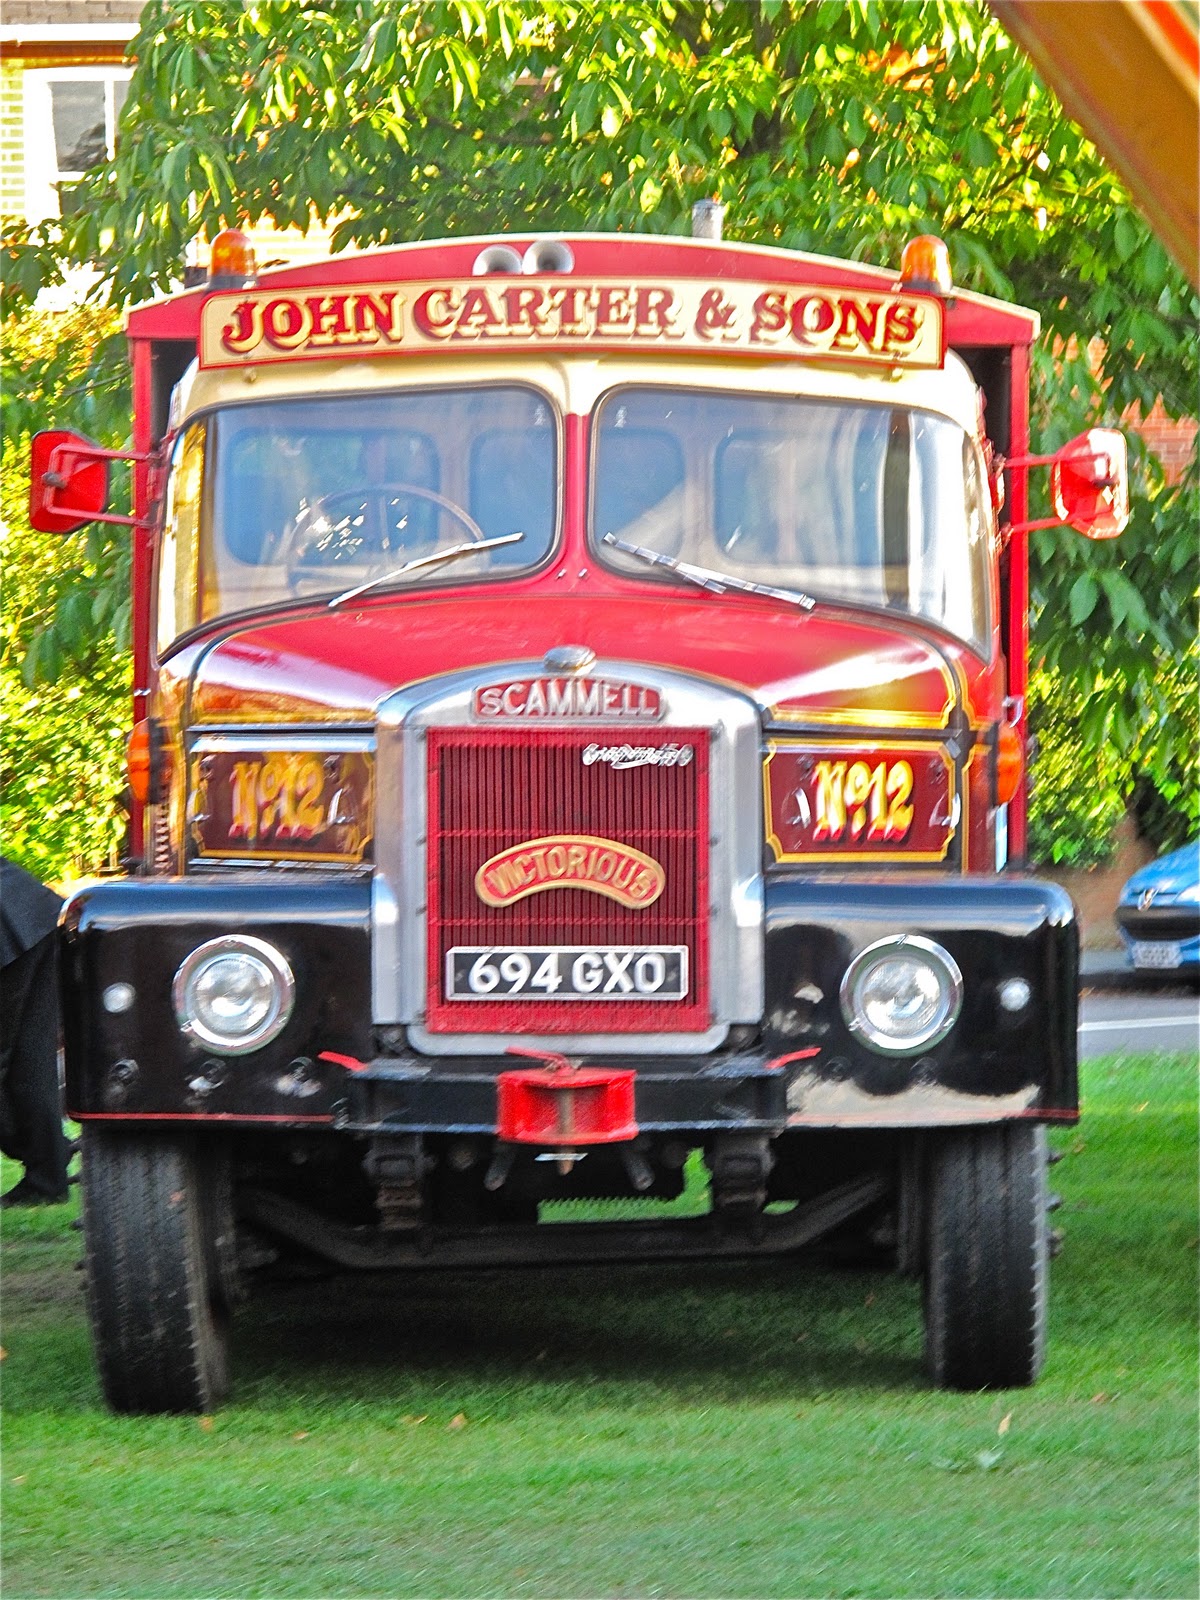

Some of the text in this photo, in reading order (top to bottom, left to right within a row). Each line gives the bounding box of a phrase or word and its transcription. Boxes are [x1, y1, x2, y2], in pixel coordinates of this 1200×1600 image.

[222, 284, 925, 357] JOHN CARTER & SONS
[478, 677, 658, 717] SCAMMELL
[485, 844, 660, 900] VICTORIOUS
[468, 951, 667, 994] 694 GXO
